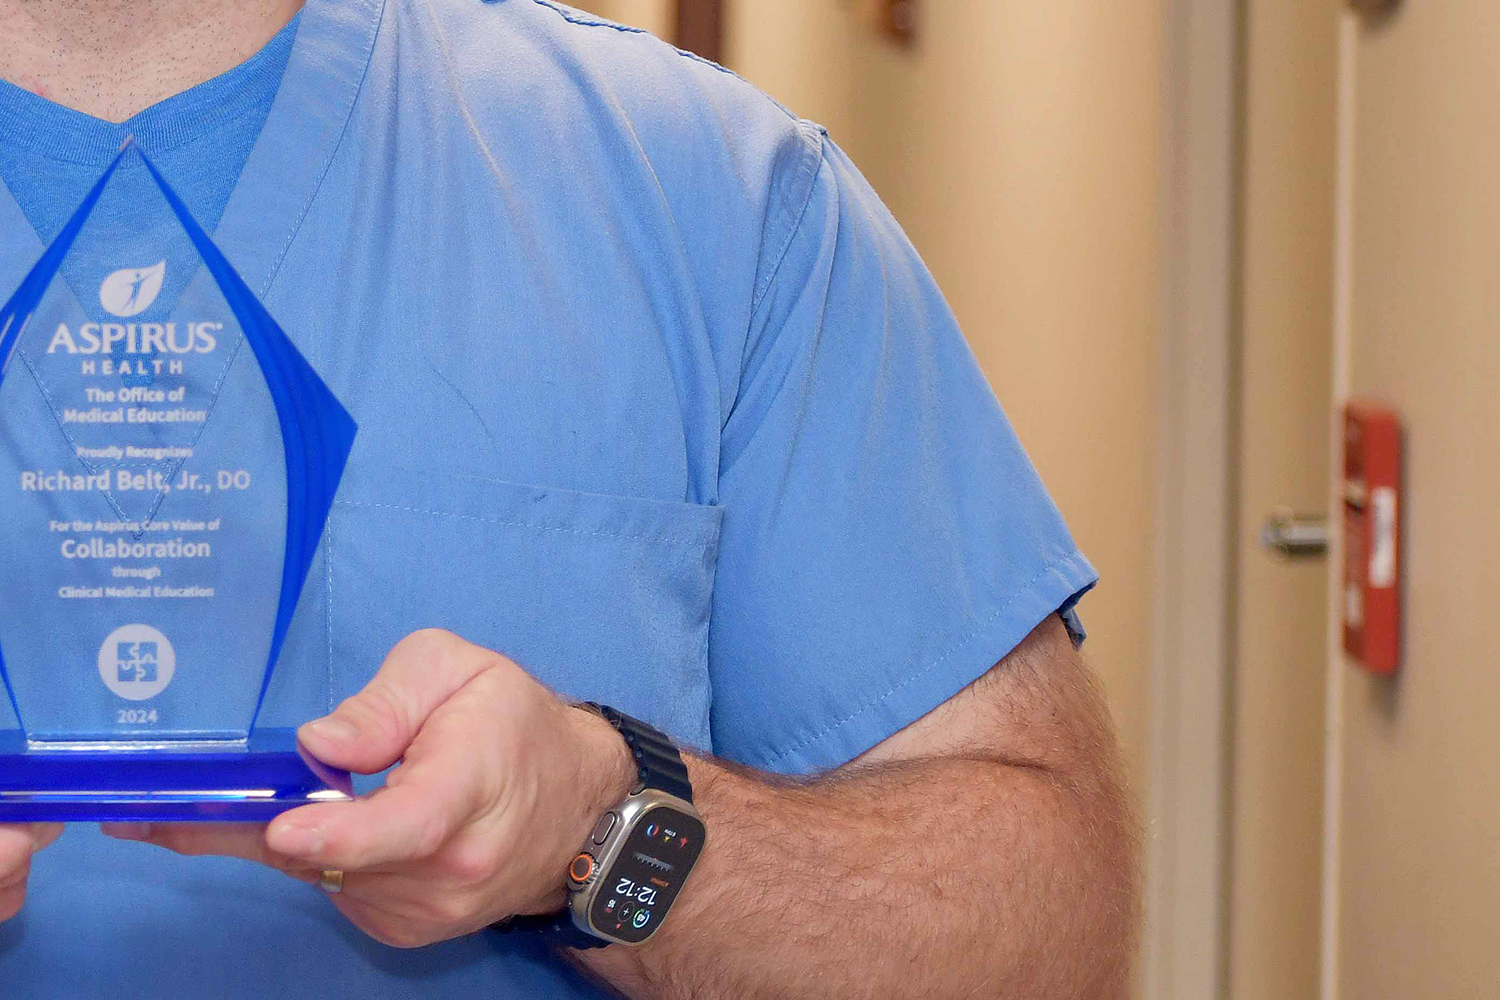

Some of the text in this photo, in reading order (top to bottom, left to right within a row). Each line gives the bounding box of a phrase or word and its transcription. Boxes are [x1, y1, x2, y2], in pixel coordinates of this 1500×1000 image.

[47, 323, 217, 354] ASPIRUS
[81, 360, 183, 375] HEALTH
[86, 386, 185, 402] The Office of
[64, 408, 206, 423] Medical Education
[76, 446, 193, 460] Proudly Recognizes
[21, 469, 250, 493] Richard Belt, Jr., DO
[50, 518, 221, 534] For the Aspirus Core Value of
[61, 537, 211, 559] Collaboration
[112, 565, 161, 580] through
[58, 585, 215, 599] Clinical Medical Education
[117, 709, 157, 724] 2024
[616, 877, 657, 905] 12:12
